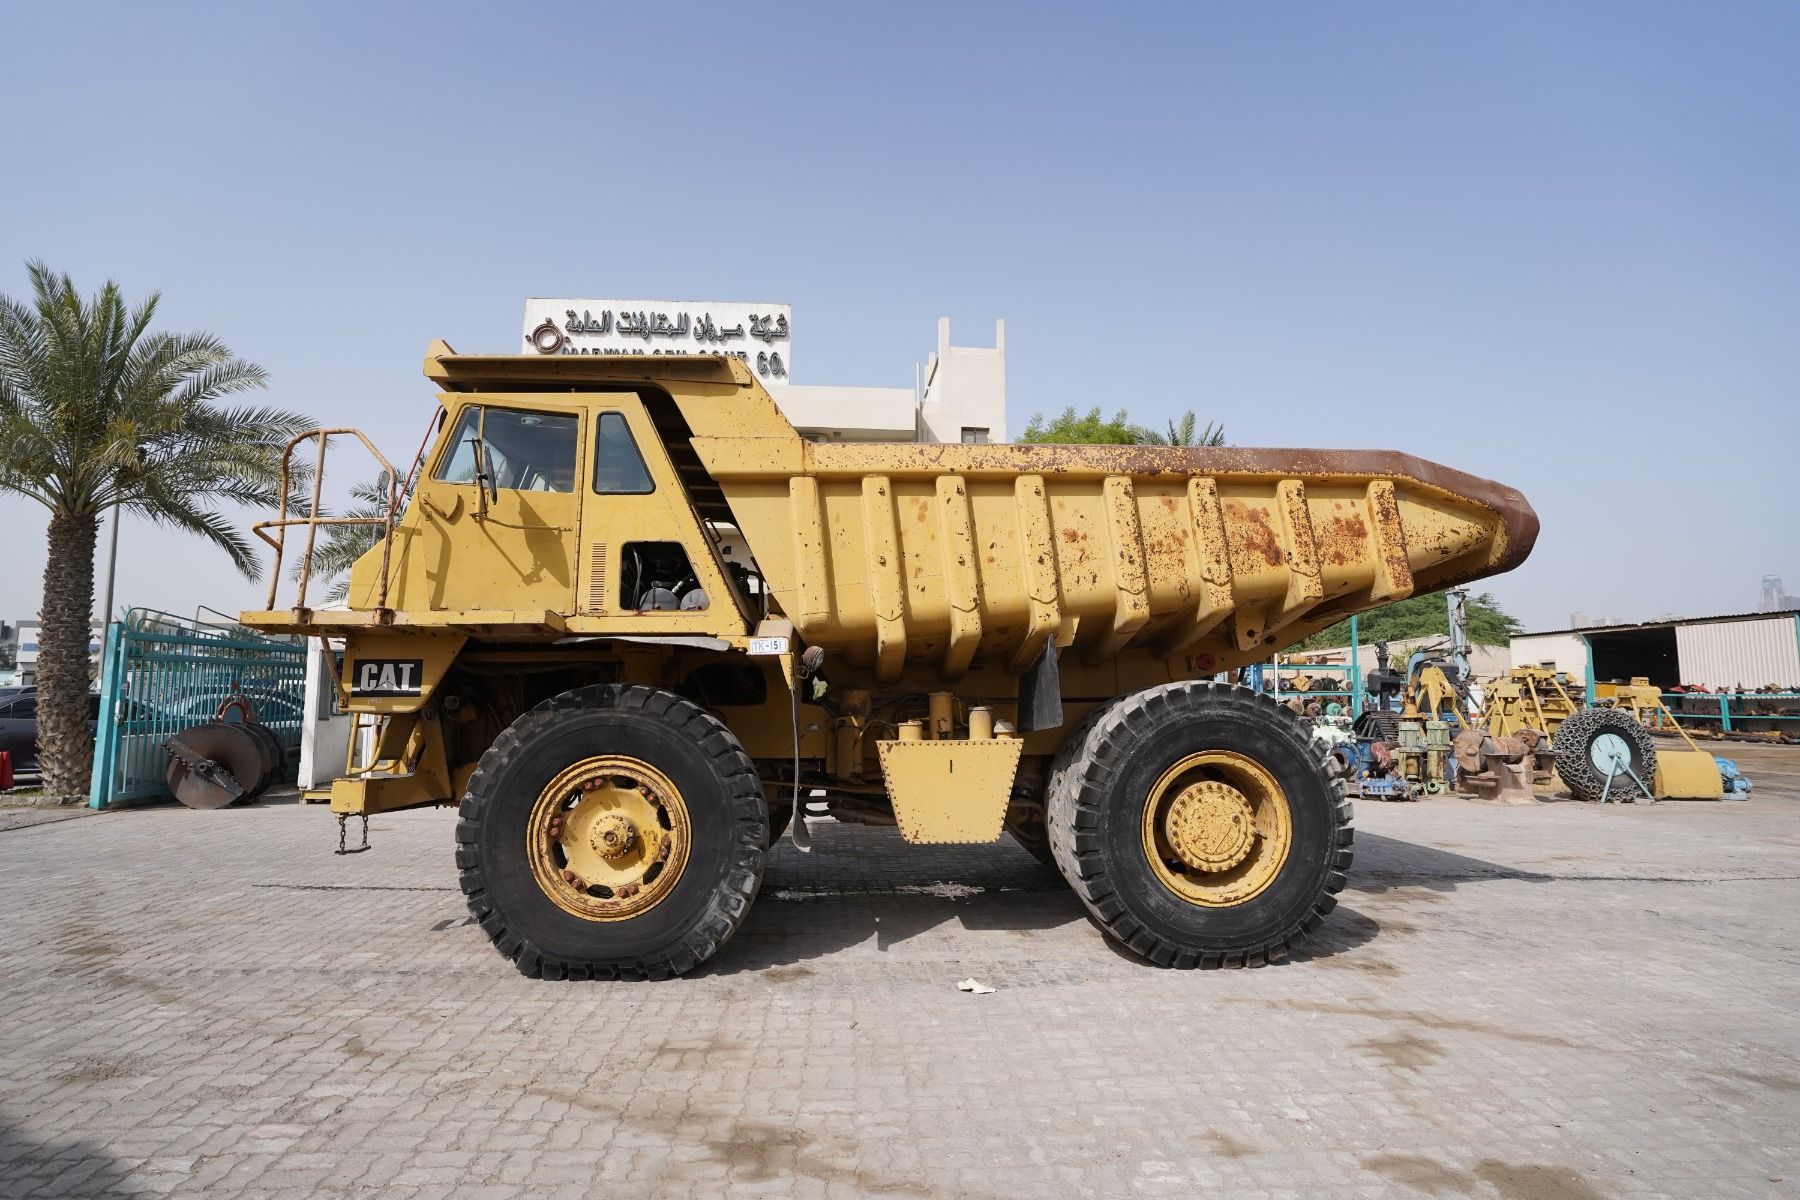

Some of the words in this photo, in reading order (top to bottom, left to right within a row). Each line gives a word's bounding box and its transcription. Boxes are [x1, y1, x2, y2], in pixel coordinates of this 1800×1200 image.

[565, 309, 611, 333] العامة
[616, 310, 688, 338] للمقاولات
[693, 312, 743, 341] مروان
[748, 313, 787, 342] شركة
[756, 351, 786, 375] CO.
[752, 640, 782, 652] TK-151
[360, 663, 414, 691] CAT
